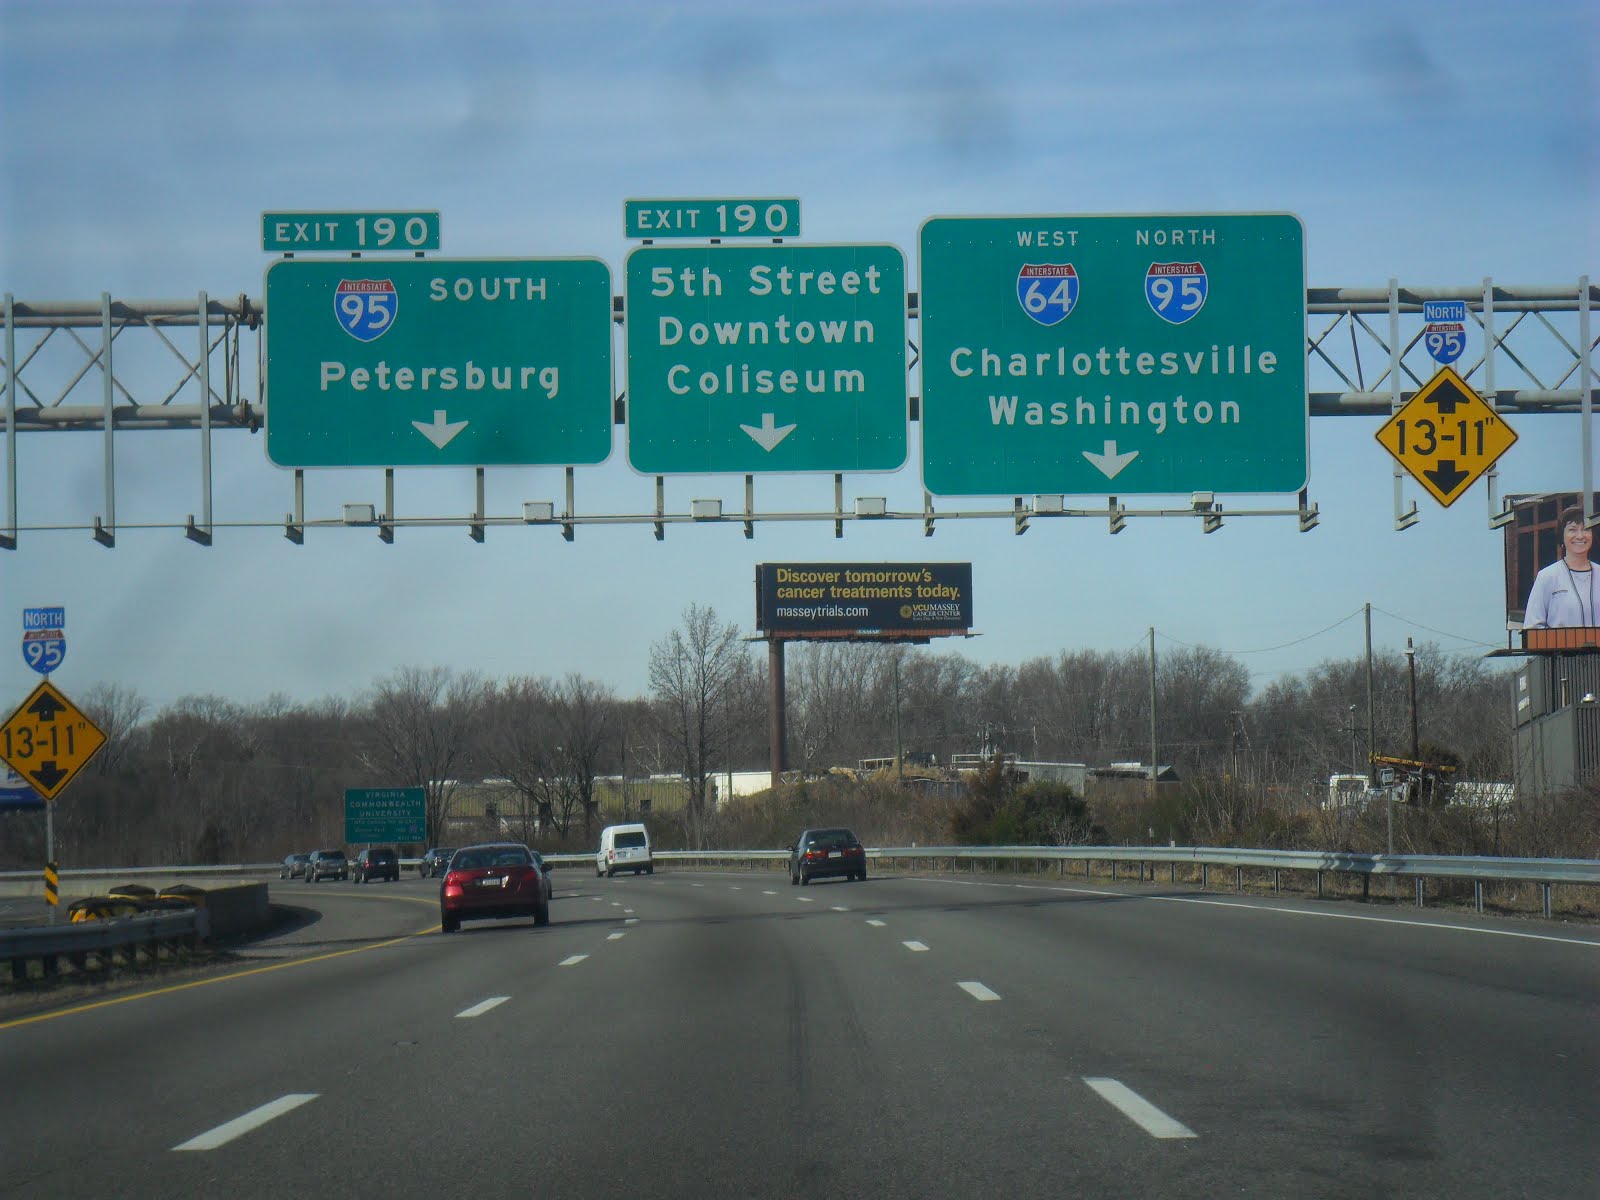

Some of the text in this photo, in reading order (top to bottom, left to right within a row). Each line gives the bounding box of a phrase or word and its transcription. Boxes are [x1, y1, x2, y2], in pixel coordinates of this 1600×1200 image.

[637, 204, 788, 232] EXIT 190
[275, 217, 428, 246] EXIT 190
[1016, 230, 1079, 247] WEST
[1136, 229, 1216, 246] NORTH
[651, 264, 881, 297] 5th Street
[1026, 266, 1069, 276] INTERSTATE
[1154, 264, 1197, 275] INTERSTATE
[344, 282, 387, 292] INTERSTATE
[429, 277, 546, 301] SOUTH
[1024, 279, 1071, 313] 64
[1150, 277, 1203, 311] 95
[340, 294, 390, 329] 95
[1426, 305, 1463, 319] NORTH
[659, 314, 874, 346] Downtown
[1429, 332, 1461, 356] 95
[949, 344, 1278, 378] Charlottesville
[320, 360, 559, 399] Petersburg
[667, 363, 865, 395] Coliseum
[988, 394, 1241, 435] Washington
[776, 568, 932, 583] Discover tomorrow's
[776, 584, 960, 600] cancer treatments today.
[25, 612, 63, 627] NORTH
[776, 604, 869, 620] masseytrials.com
[27, 641, 62, 666] 95
